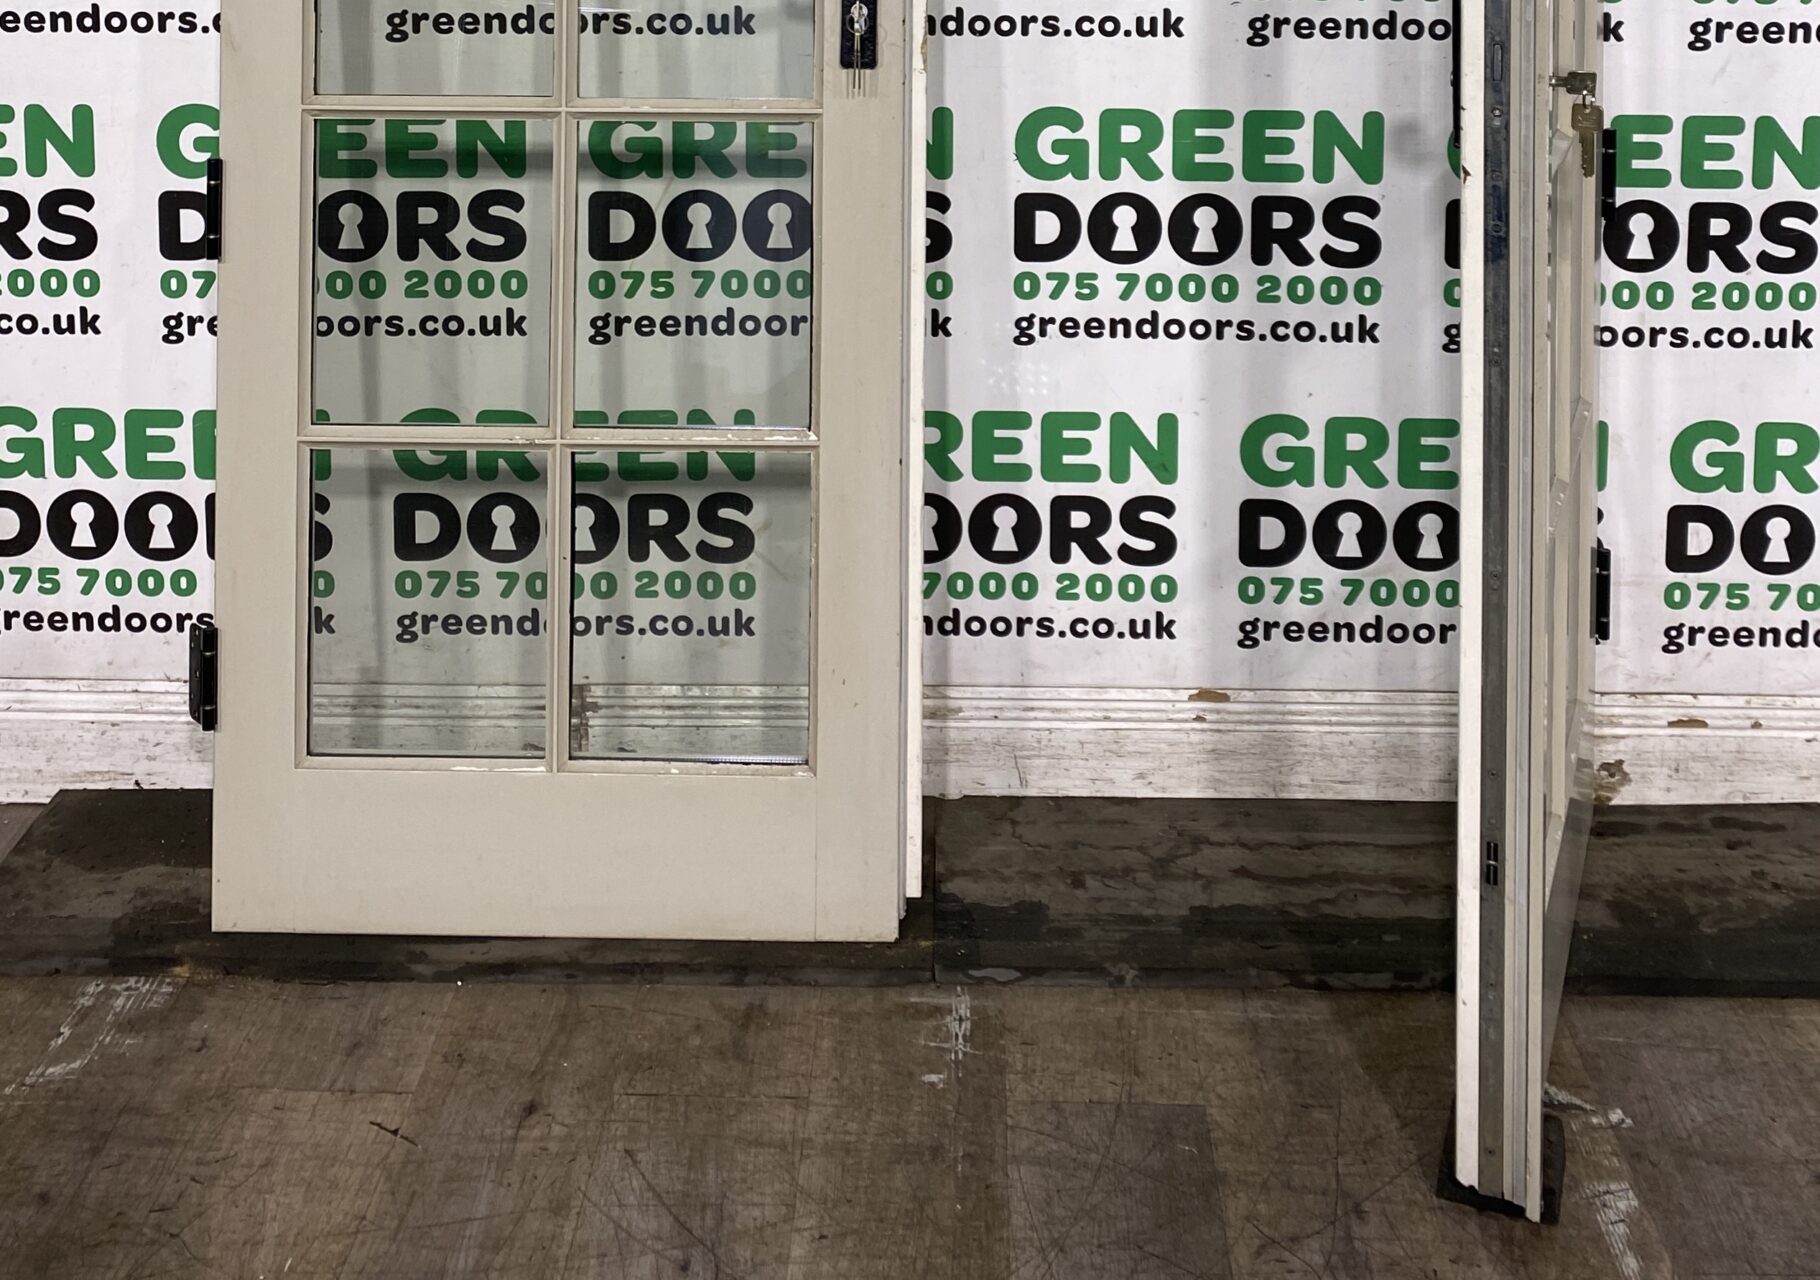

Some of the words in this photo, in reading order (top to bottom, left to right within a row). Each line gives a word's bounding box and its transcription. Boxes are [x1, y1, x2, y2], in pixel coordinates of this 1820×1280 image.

[385, 4, 756, 43] greendors.co.uk
[1015, 106, 1385, 185] GREEN
[1013, 191, 1382, 269] DOORS
[0, 268, 101, 298] 000
[404, 270, 528, 300] 2000
[588, 270, 674, 300] 075
[691, 270, 812, 300] 7000
[1013, 271, 1099, 302] 075
[1116, 272, 1240, 303] 7000
[1256, 274, 1382, 306] 2000
[1691, 281, 1817, 312] 2000
[1012, 309, 1380, 346] greendoors.co.uk
[393, 491, 755, 564] DOORS
[0, 567, 61, 595] 75
[76, 568, 197, 597] 7000
[394, 570, 480, 599] 075
[635, 570, 756, 600] 2000
[923, 571, 1039, 601] 7000
[1056, 573, 1178, 603] 2000
[1238, 576, 1324, 607] 075
[1340, 578, 1460, 608] 7000
[1663, 582, 1750, 611] 075
[396, 607, 756, 644] greendors.co.uk
